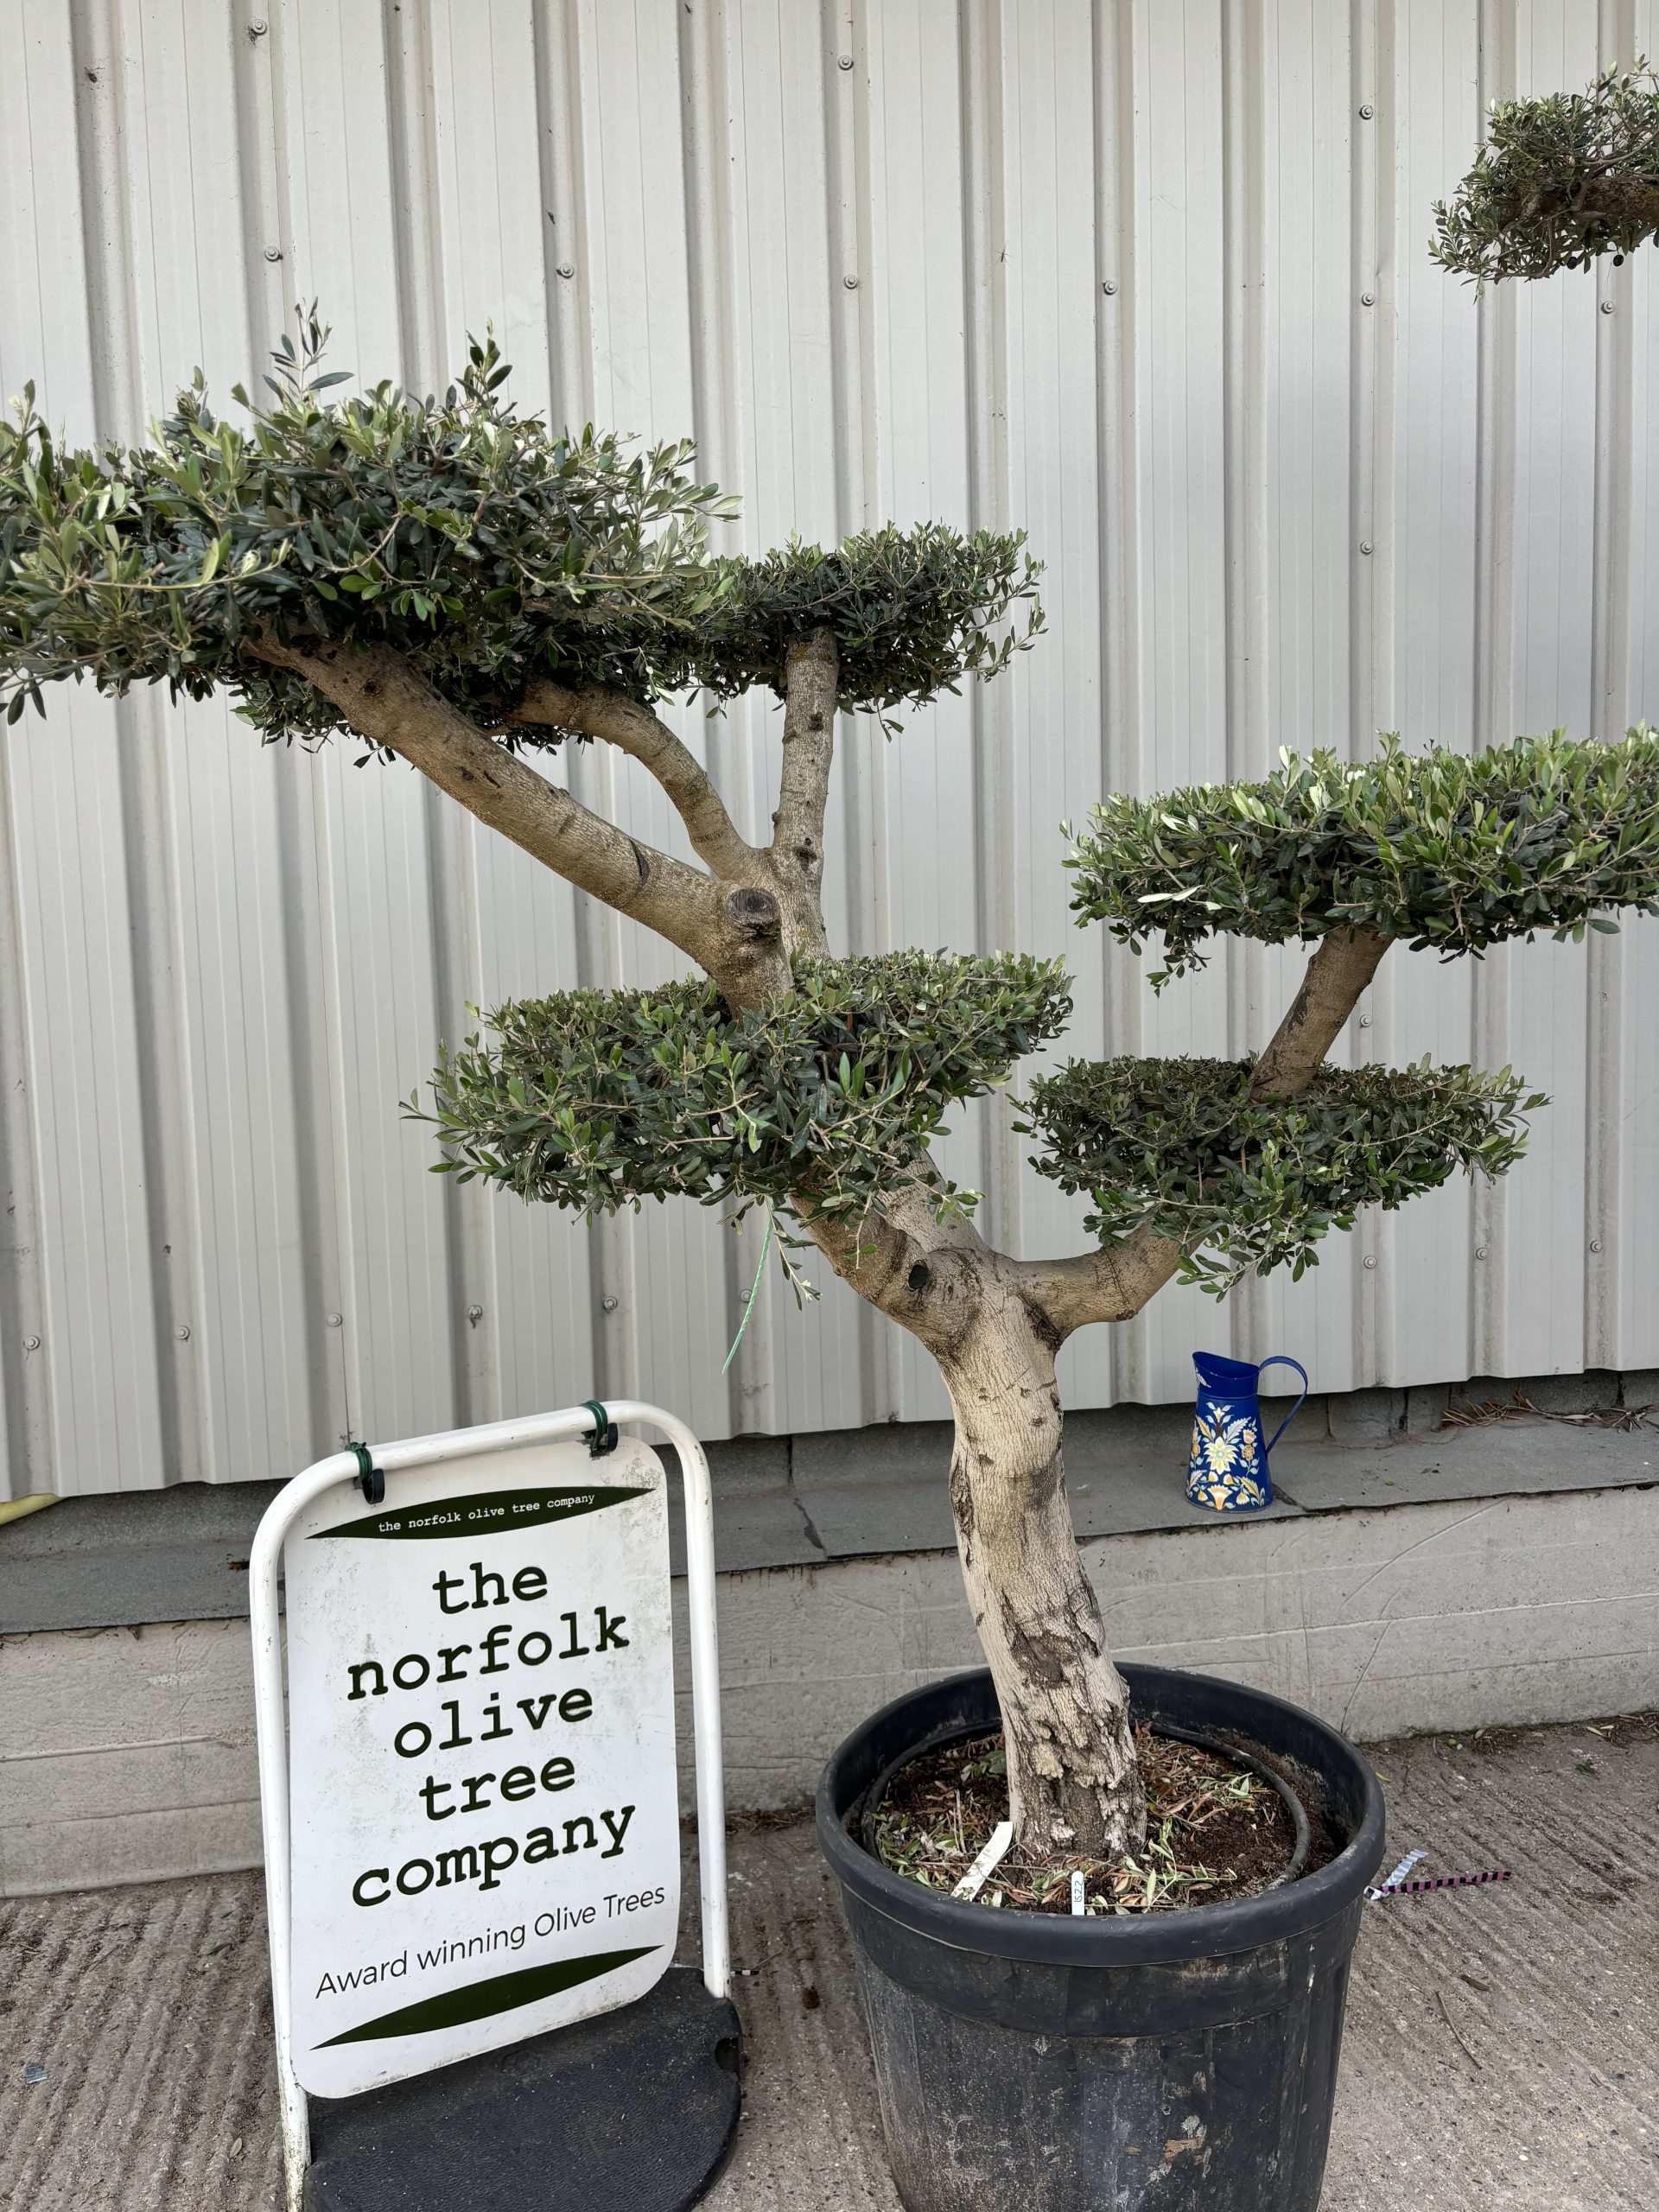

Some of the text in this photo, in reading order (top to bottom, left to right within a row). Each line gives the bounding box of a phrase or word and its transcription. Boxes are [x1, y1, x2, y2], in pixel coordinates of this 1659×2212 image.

[378, 1494, 595, 1532] the norfolk olive tree company
[432, 1561, 548, 1615] the
[346, 1605, 630, 1700] norfolk
[394, 1688, 593, 1758] olive
[418, 1757, 575, 1821] tree
[352, 1804, 636, 1907] company
[315, 1886, 665, 1999] Award winning Olive Trees
